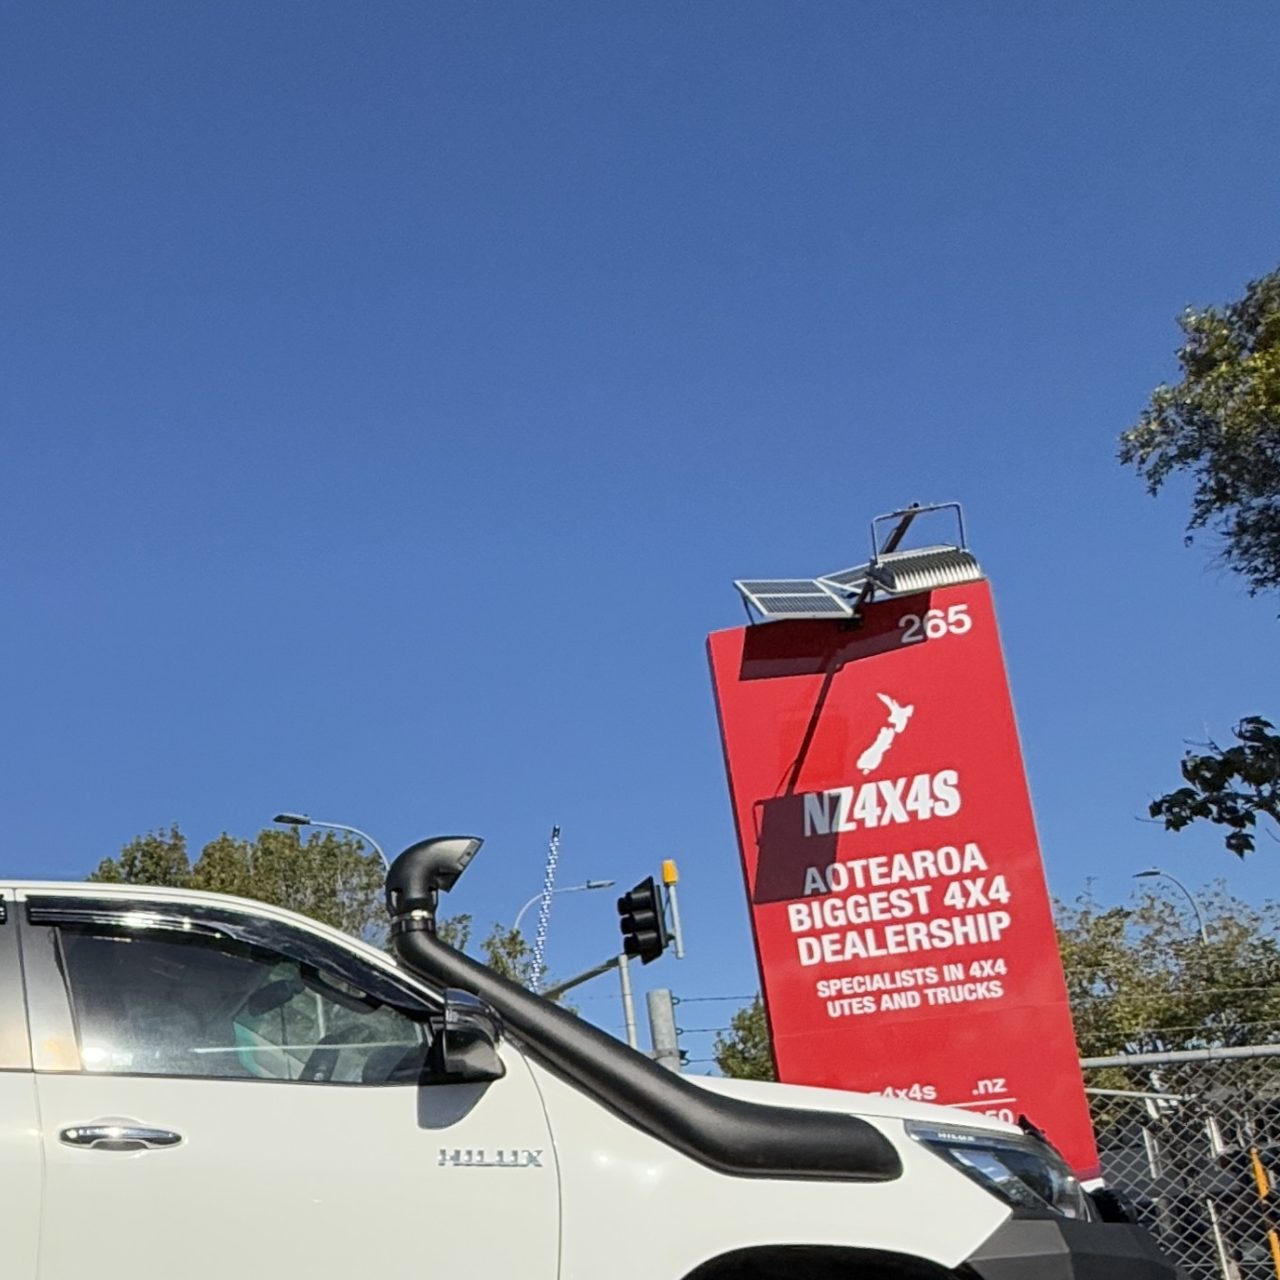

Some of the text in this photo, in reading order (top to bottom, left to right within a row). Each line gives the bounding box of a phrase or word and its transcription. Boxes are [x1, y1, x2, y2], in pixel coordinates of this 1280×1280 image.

[898, 603, 972, 643] 265
[803, 769, 962, 837] NZ4X4S
[803, 842, 988, 896] AOTEAROA
[787, 874, 1011, 933] BIGGEST 4X4
[796, 910, 1011, 966] DEALERSHIP
[816, 958, 1007, 998] SPECIALISTS IN 4X4
[826, 980, 1004, 1018] UTES AND TRUCKS
[870, 1083, 938, 1100] 4x4s
[438, 1148, 543, 1167] HILUX
